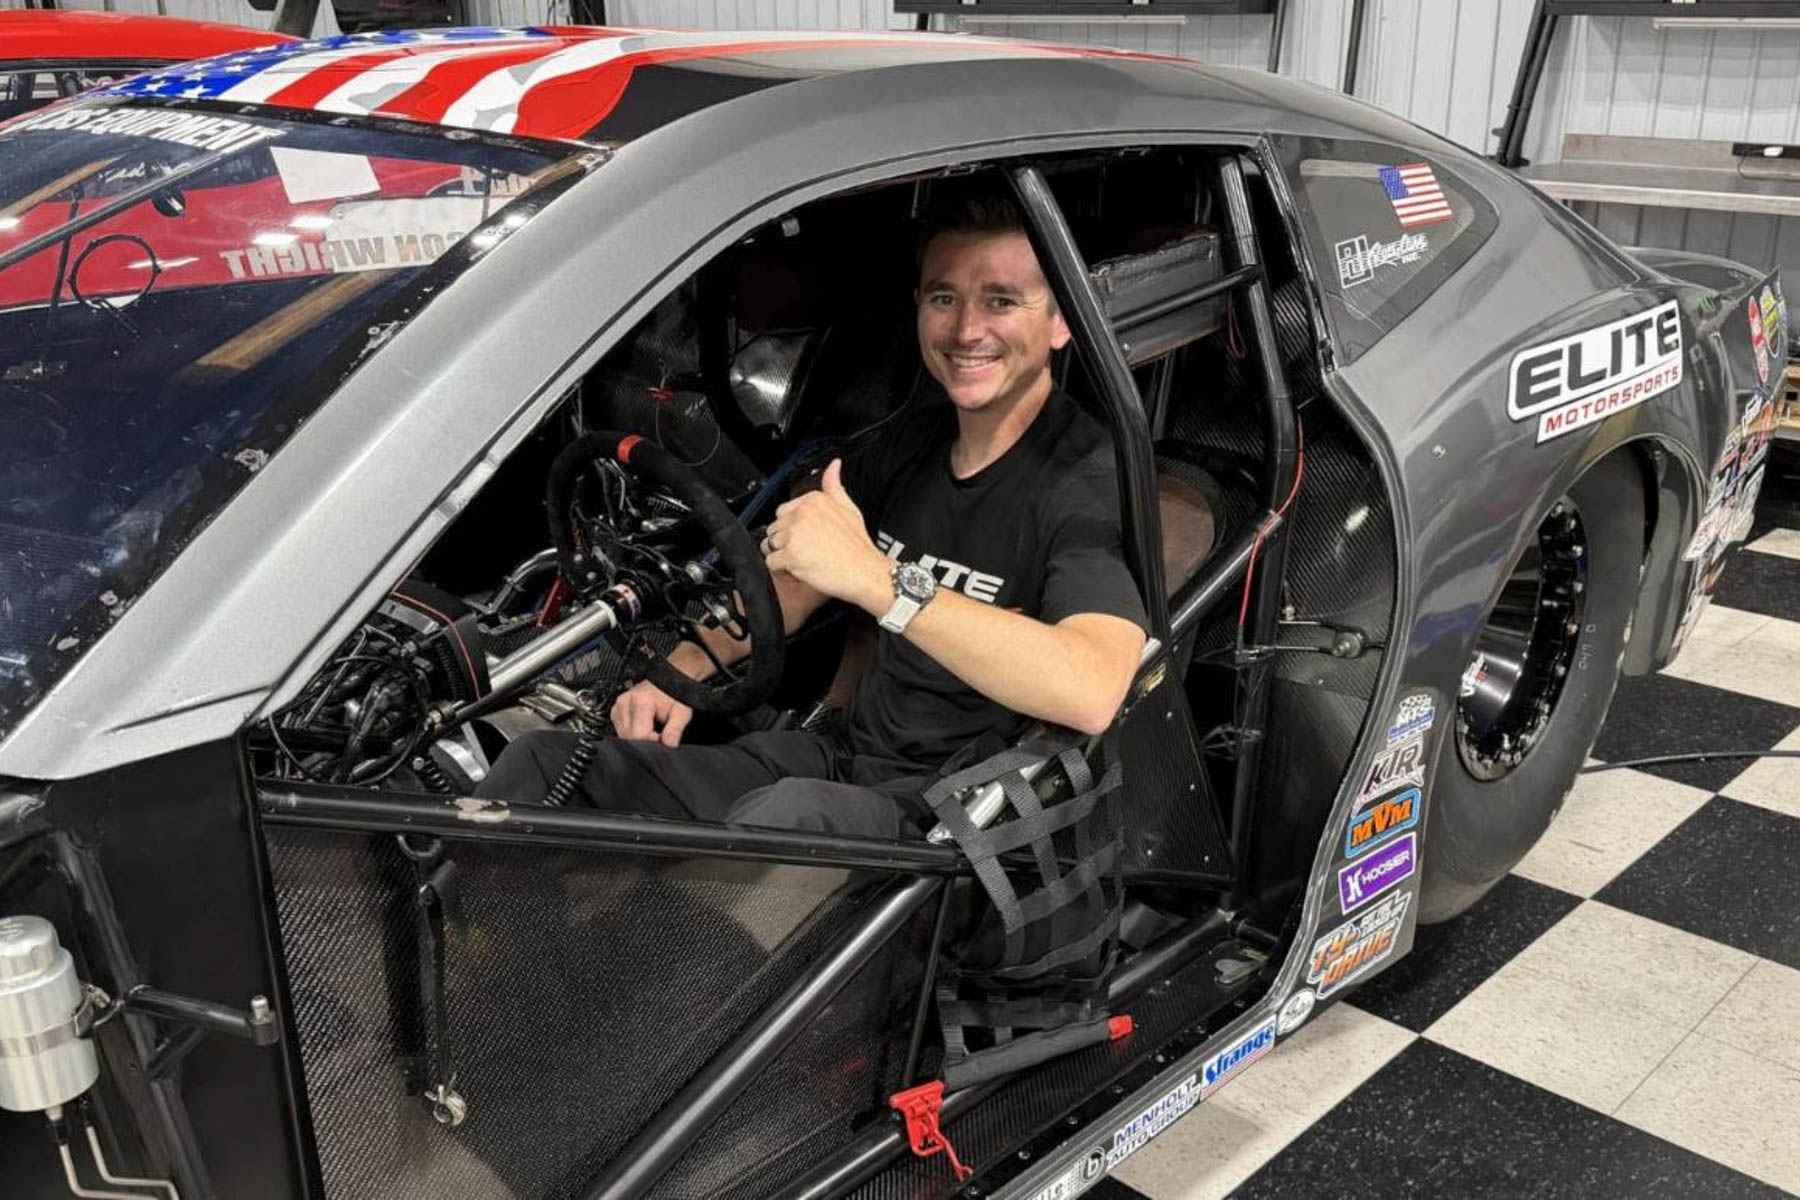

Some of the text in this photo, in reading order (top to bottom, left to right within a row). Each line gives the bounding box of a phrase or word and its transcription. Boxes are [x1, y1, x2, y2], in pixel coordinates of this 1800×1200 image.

[84, 108, 287, 154] EQUIPMENT
[1515, 307, 1680, 410] ELITE
[1545, 366, 1679, 433] MOTORSPORTS
[1351, 800, 1413, 846] MVM
[1110, 1091, 1200, 1163] AUTO GROUP
[1115, 1080, 1196, 1146] MENHOLT
